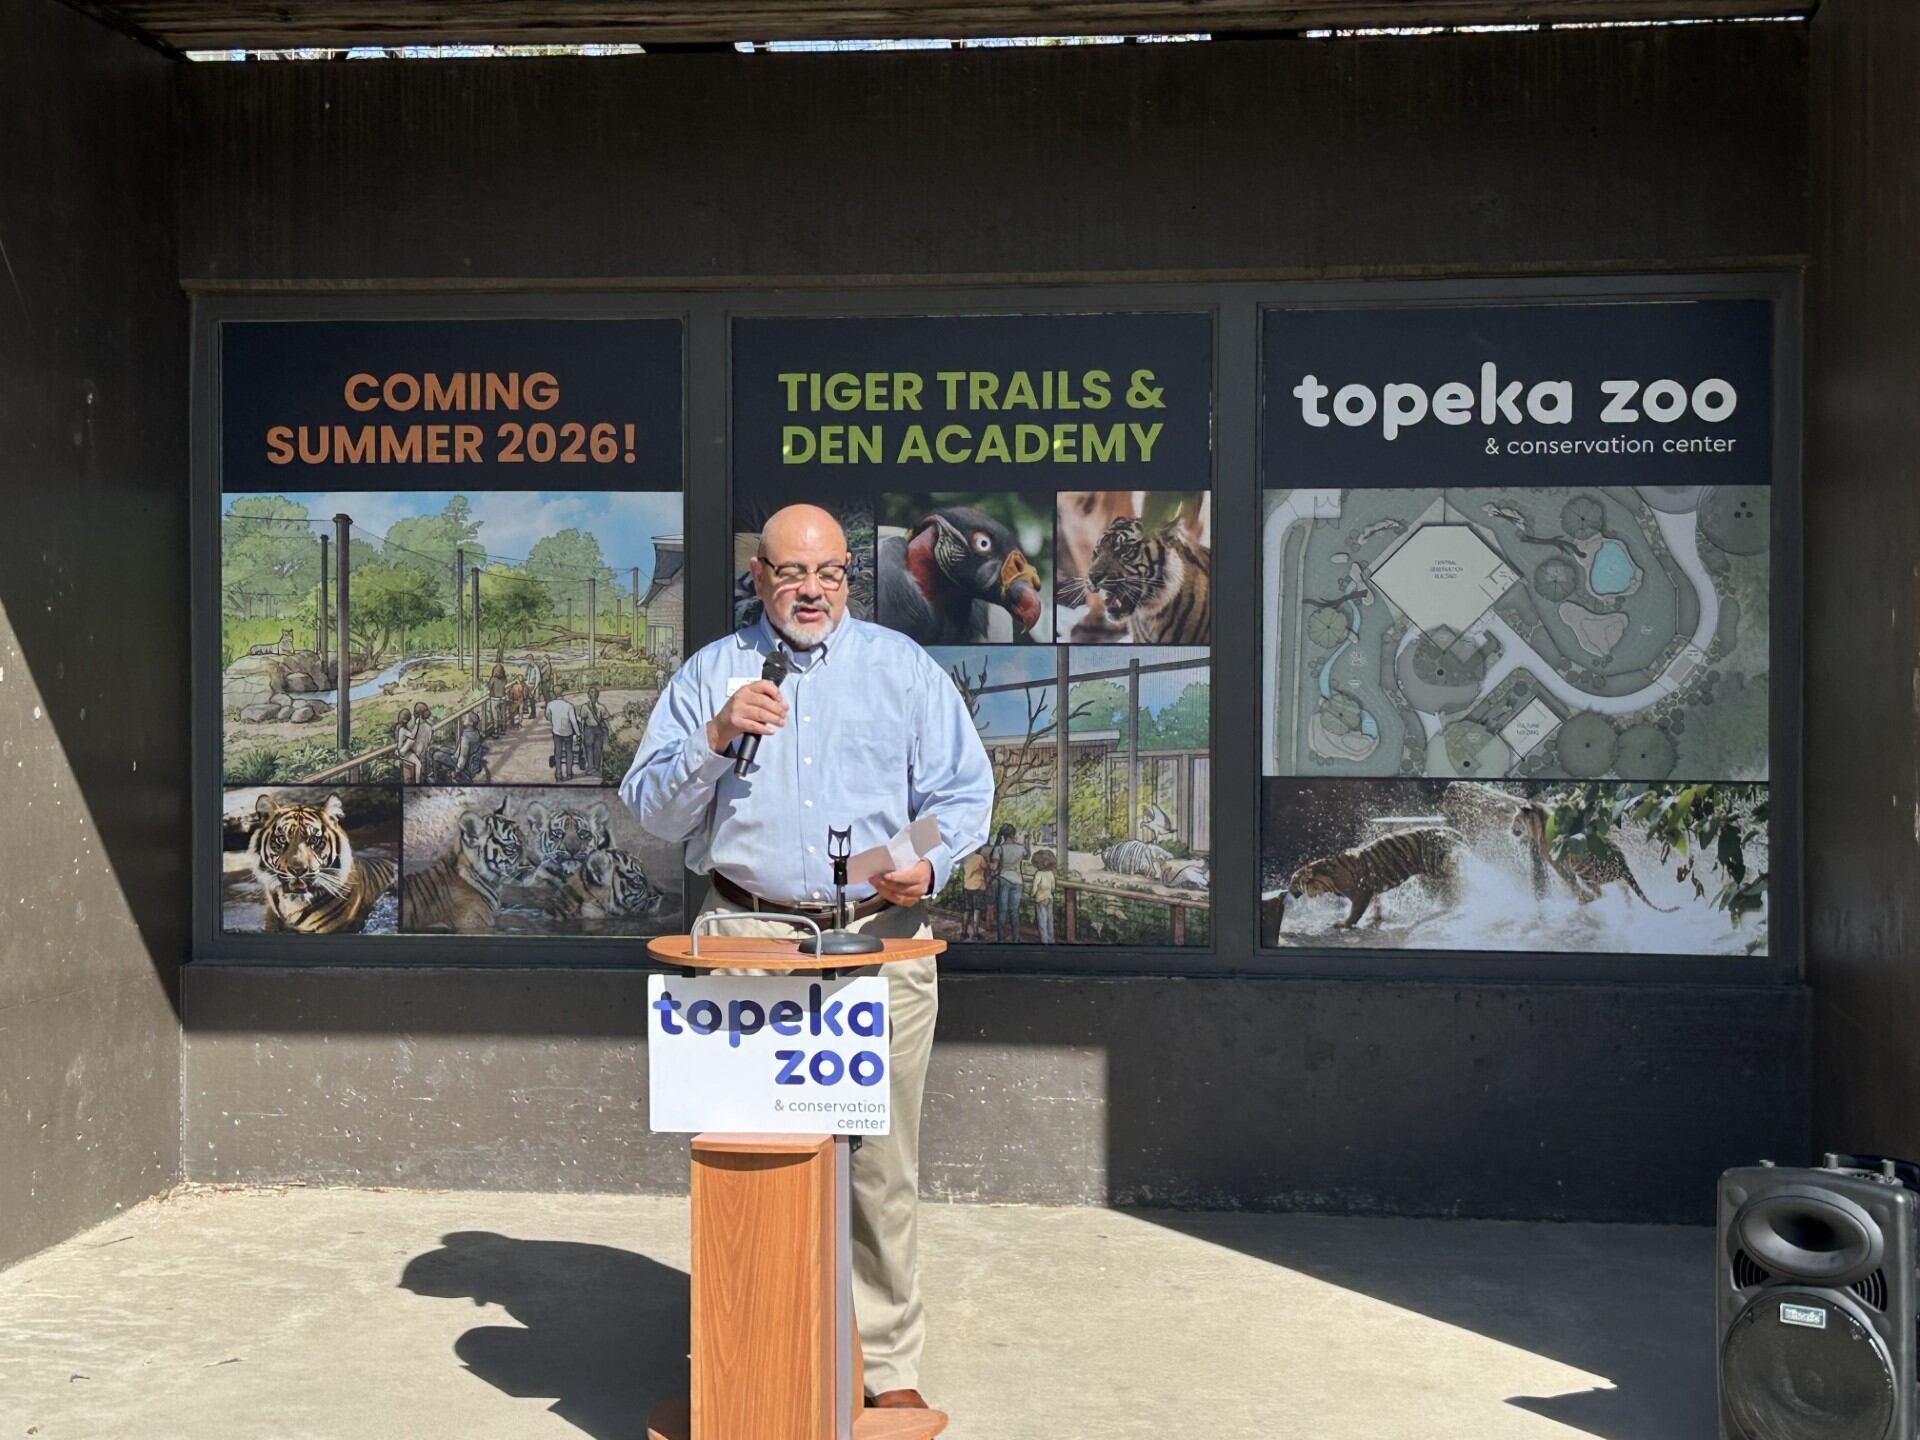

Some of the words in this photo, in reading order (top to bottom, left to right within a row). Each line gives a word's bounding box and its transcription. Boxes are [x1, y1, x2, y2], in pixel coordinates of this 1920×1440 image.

[344, 371, 560, 412] COMING
[778, 371, 923, 412] TIGER
[936, 369, 1112, 411] TRAILS
[1125, 369, 1166, 409] &
[1293, 361, 1573, 441] topeka
[1599, 378, 1737, 423] zoo
[266, 424, 484, 465] SUMMER
[497, 422, 636, 464] 2026!
[782, 425, 883, 464] DEN
[896, 423, 1165, 464] ACADEMY
[1484, 437, 1500, 455] &
[1506, 434, 1654, 455] conservation
[1662, 436, 1737, 454] center
[652, 983, 885, 1049] topeka
[774, 1049, 885, 1088] zoo
[774, 1099, 785, 1113] &
[788, 1100, 886, 1114] conservation
[836, 1117, 886, 1130] center
